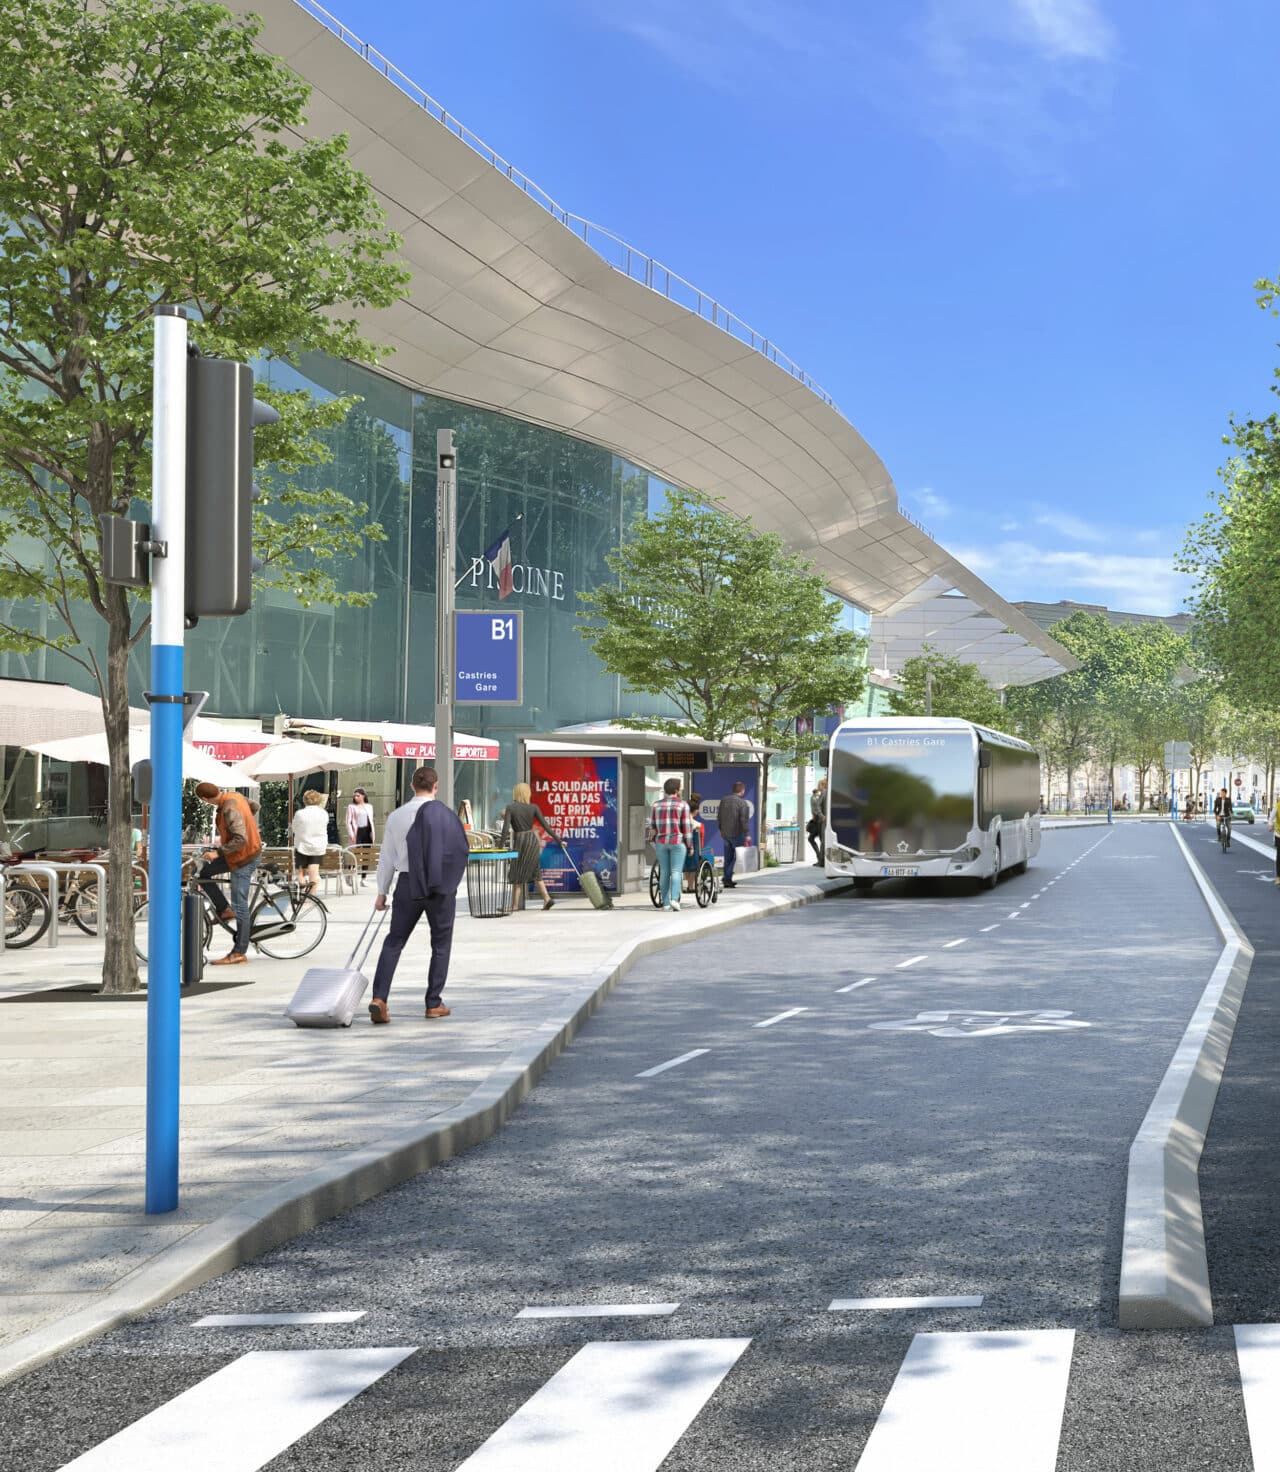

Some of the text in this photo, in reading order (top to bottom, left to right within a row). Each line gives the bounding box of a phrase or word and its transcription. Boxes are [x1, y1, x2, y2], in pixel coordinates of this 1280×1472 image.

[470, 557, 565, 600] PICINE
[492, 618, 513, 640] B1
[458, 671, 497, 680] Castries
[475, 683, 498, 692] Gare
[867, 737, 945, 746] B1 Castries Gare
[536, 778, 613, 793] LA SOLIDARITÉ,
[581, 793, 600, 804] PAS
[554, 805, 594, 815] DE PRIX.
[564, 816, 575, 827] ET
[577, 816, 604, 827] TRAM
[552, 828, 600, 839] RATUITS.
